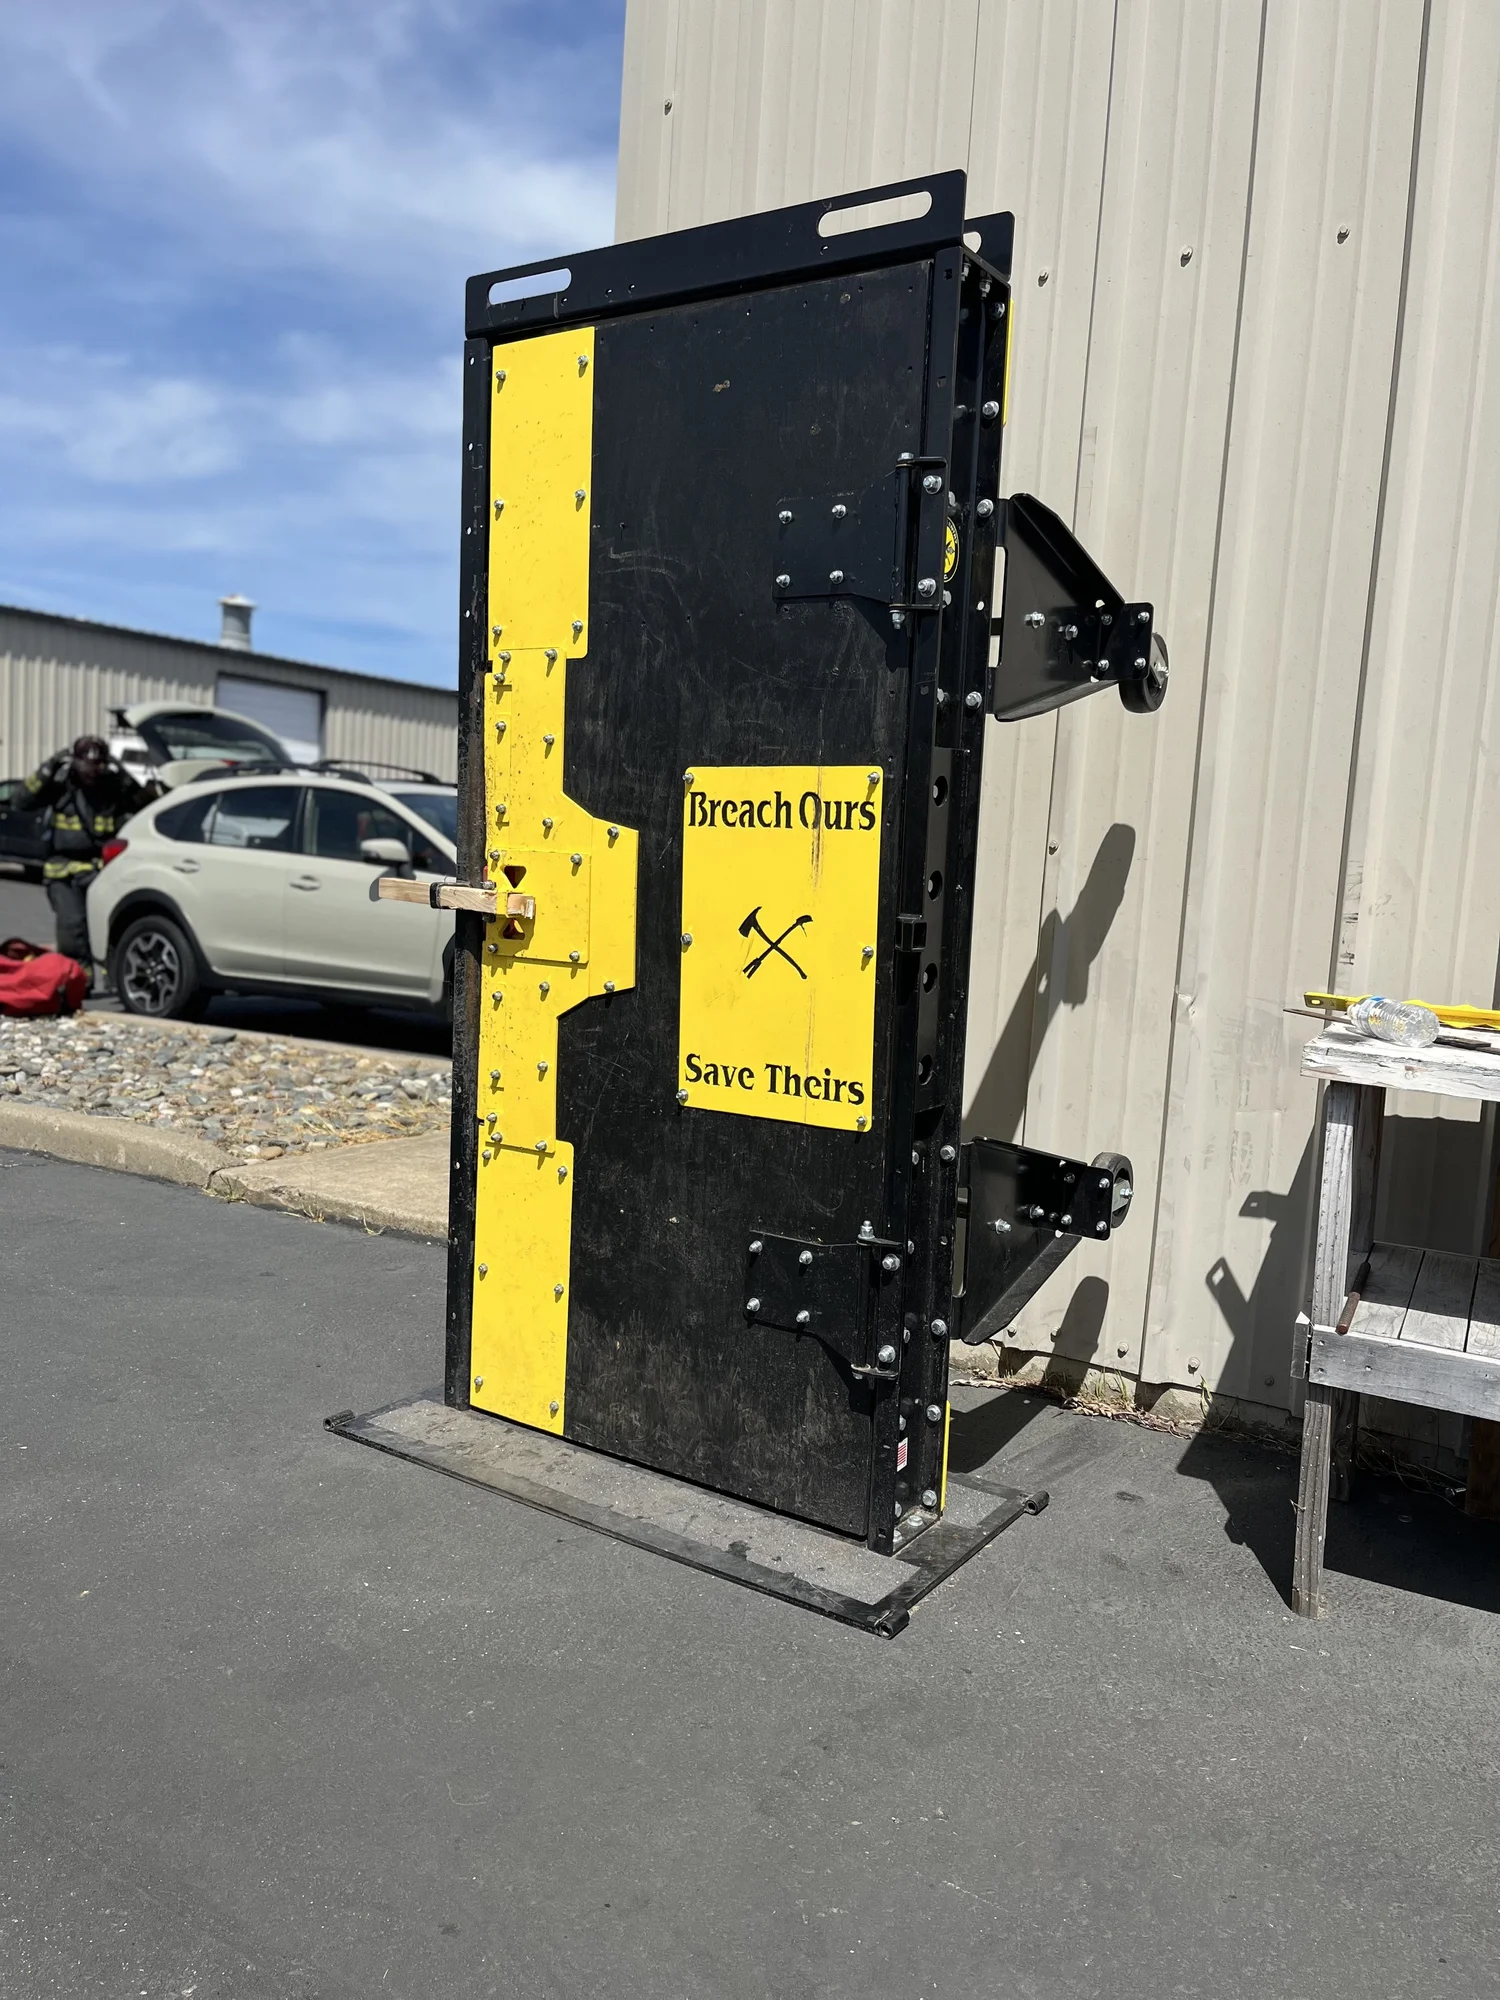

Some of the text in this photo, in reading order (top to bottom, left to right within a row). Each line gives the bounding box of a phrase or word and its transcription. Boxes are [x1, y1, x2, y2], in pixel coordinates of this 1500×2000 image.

[687, 791, 876, 831] Breach Ours
[685, 1053, 865, 1106] Save Theirs
